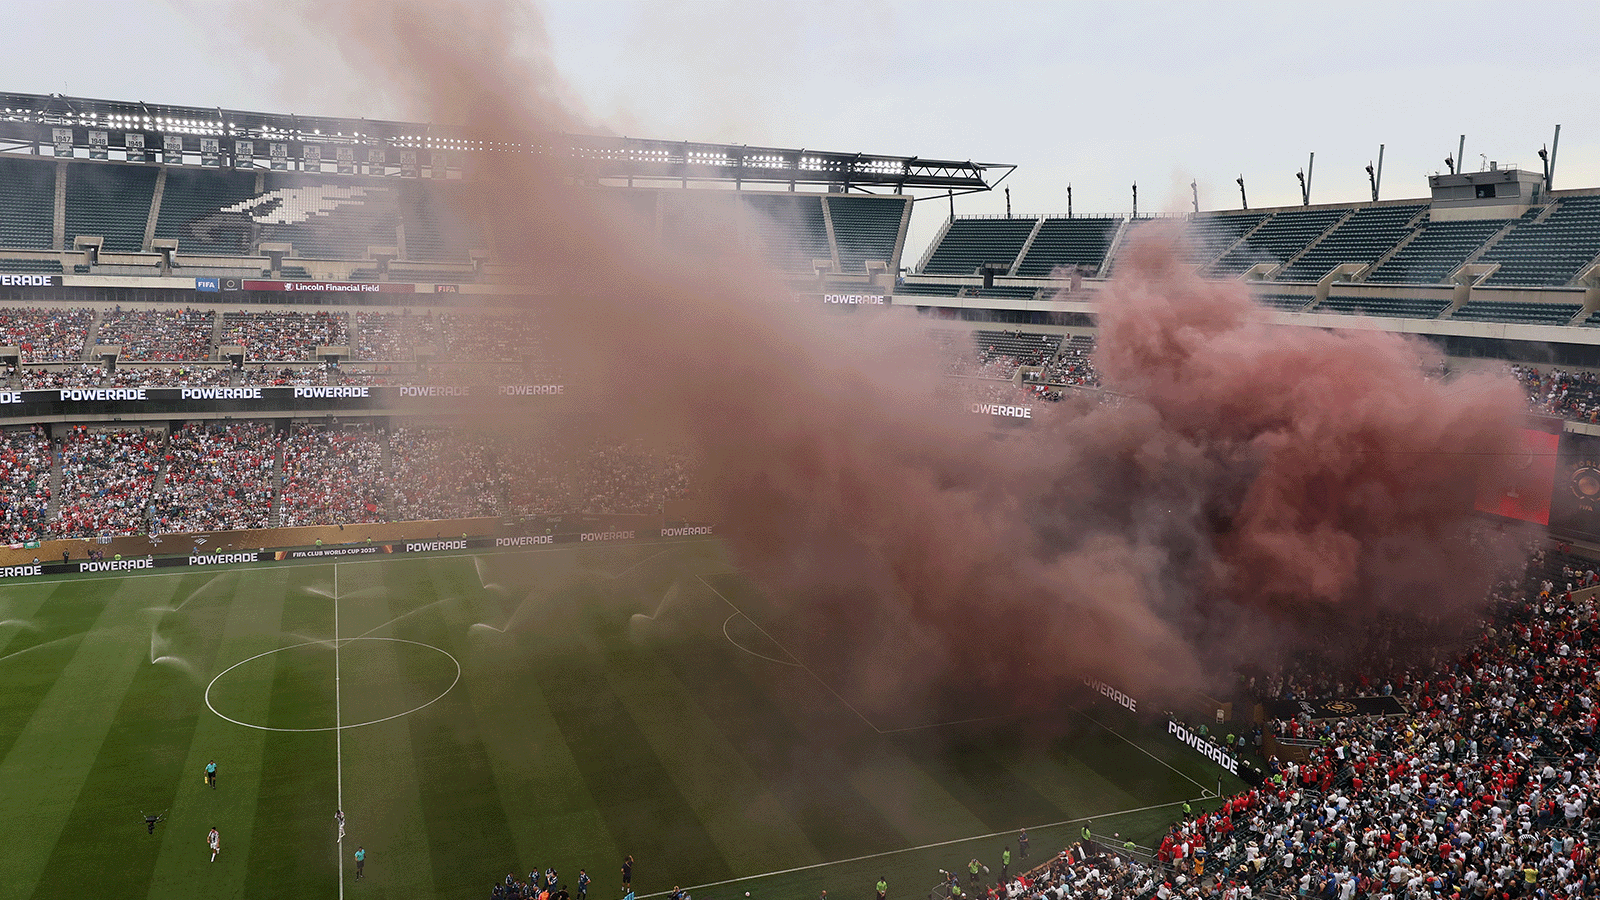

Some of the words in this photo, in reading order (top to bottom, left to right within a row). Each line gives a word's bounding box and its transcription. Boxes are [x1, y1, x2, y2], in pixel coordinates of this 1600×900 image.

[0, 275, 52, 286] ERADE
[295, 283, 324, 291] Lincoln
[361, 284, 380, 292] Field
[824, 294, 884, 305] POWERADE
[60, 389, 147, 401] POWERADE
[181, 388, 262, 400] POWERADE
[294, 387, 369, 398] POWERADE
[400, 386, 470, 397] POWERADE
[499, 385, 564, 396] POWERADE
[580, 530, 635, 542] POWERADE
[661, 526, 712, 537] POWERADE
[406, 540, 467, 552] POWERADE
[496, 535, 553, 547] POWERADE
[188, 552, 258, 566] POWERADE
[79, 558, 153, 573] POWERADE
[1168, 720, 1239, 775] POWERADE
